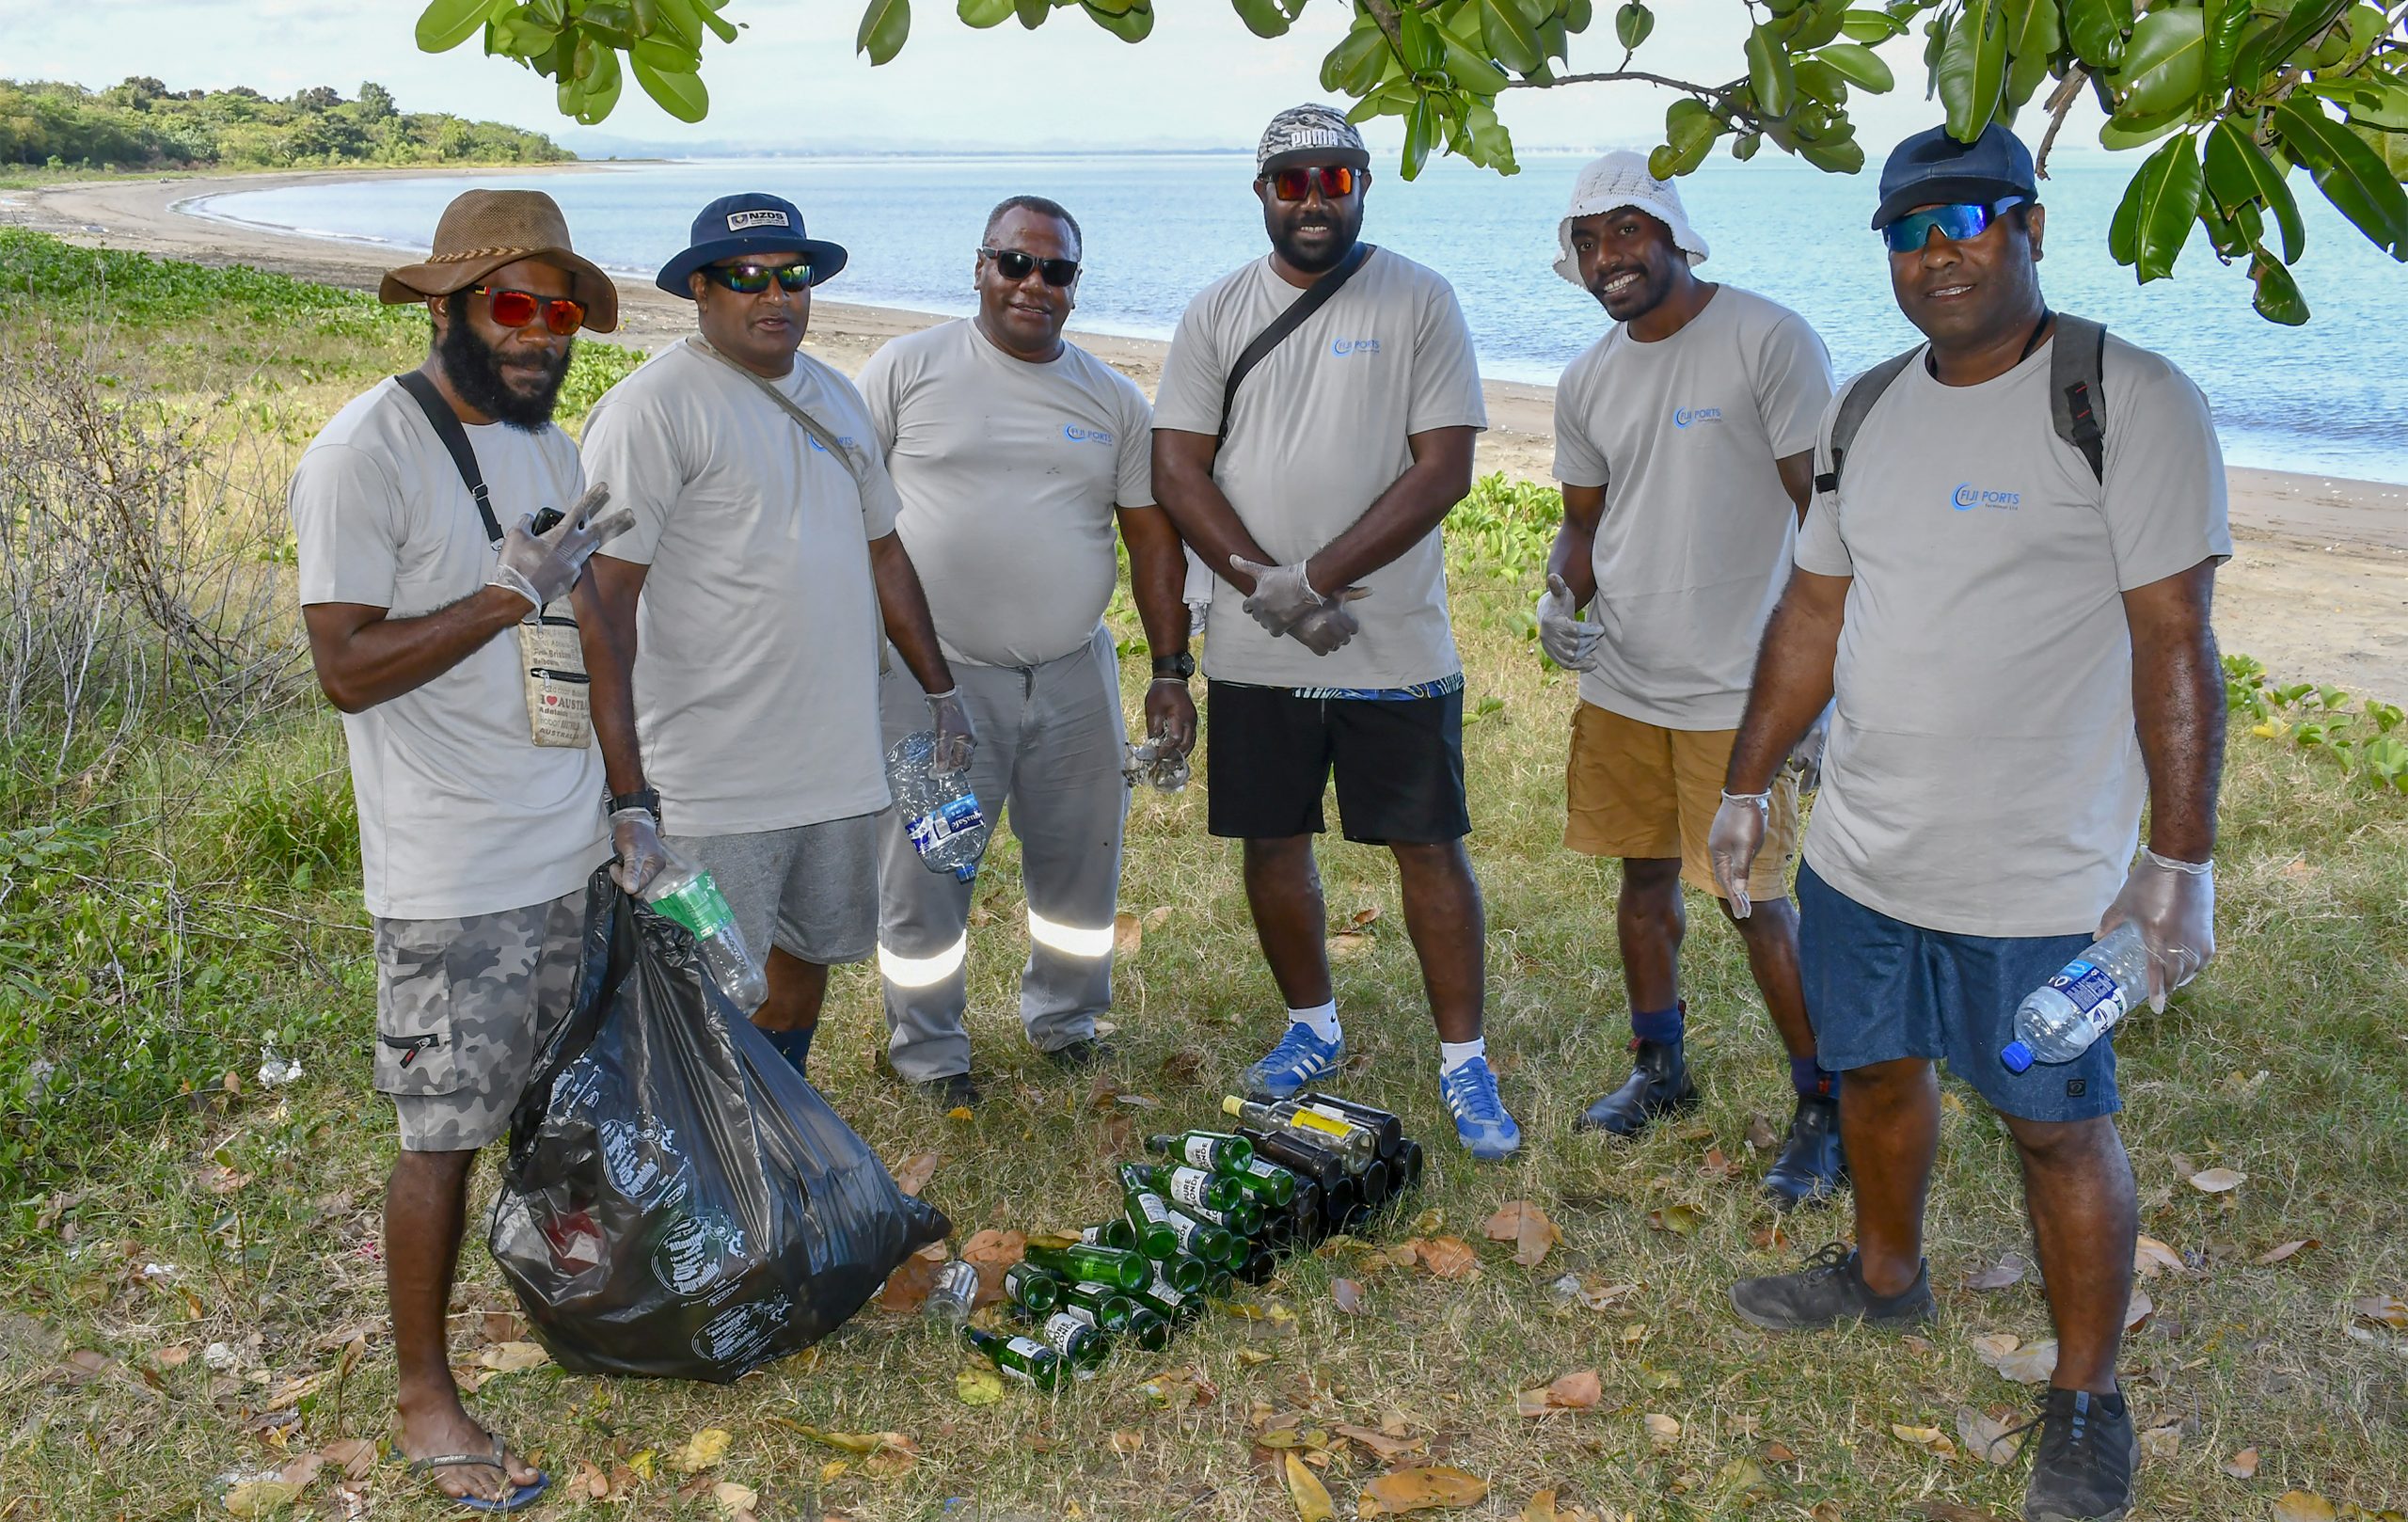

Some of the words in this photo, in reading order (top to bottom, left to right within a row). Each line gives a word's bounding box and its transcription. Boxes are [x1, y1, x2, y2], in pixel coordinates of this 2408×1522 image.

[1291, 129, 1339, 148] PUMA
[1695, 408, 1721, 419] PORTS
[1961, 489, 1979, 500] FIJI
[1982, 491, 2020, 504] PORTS
